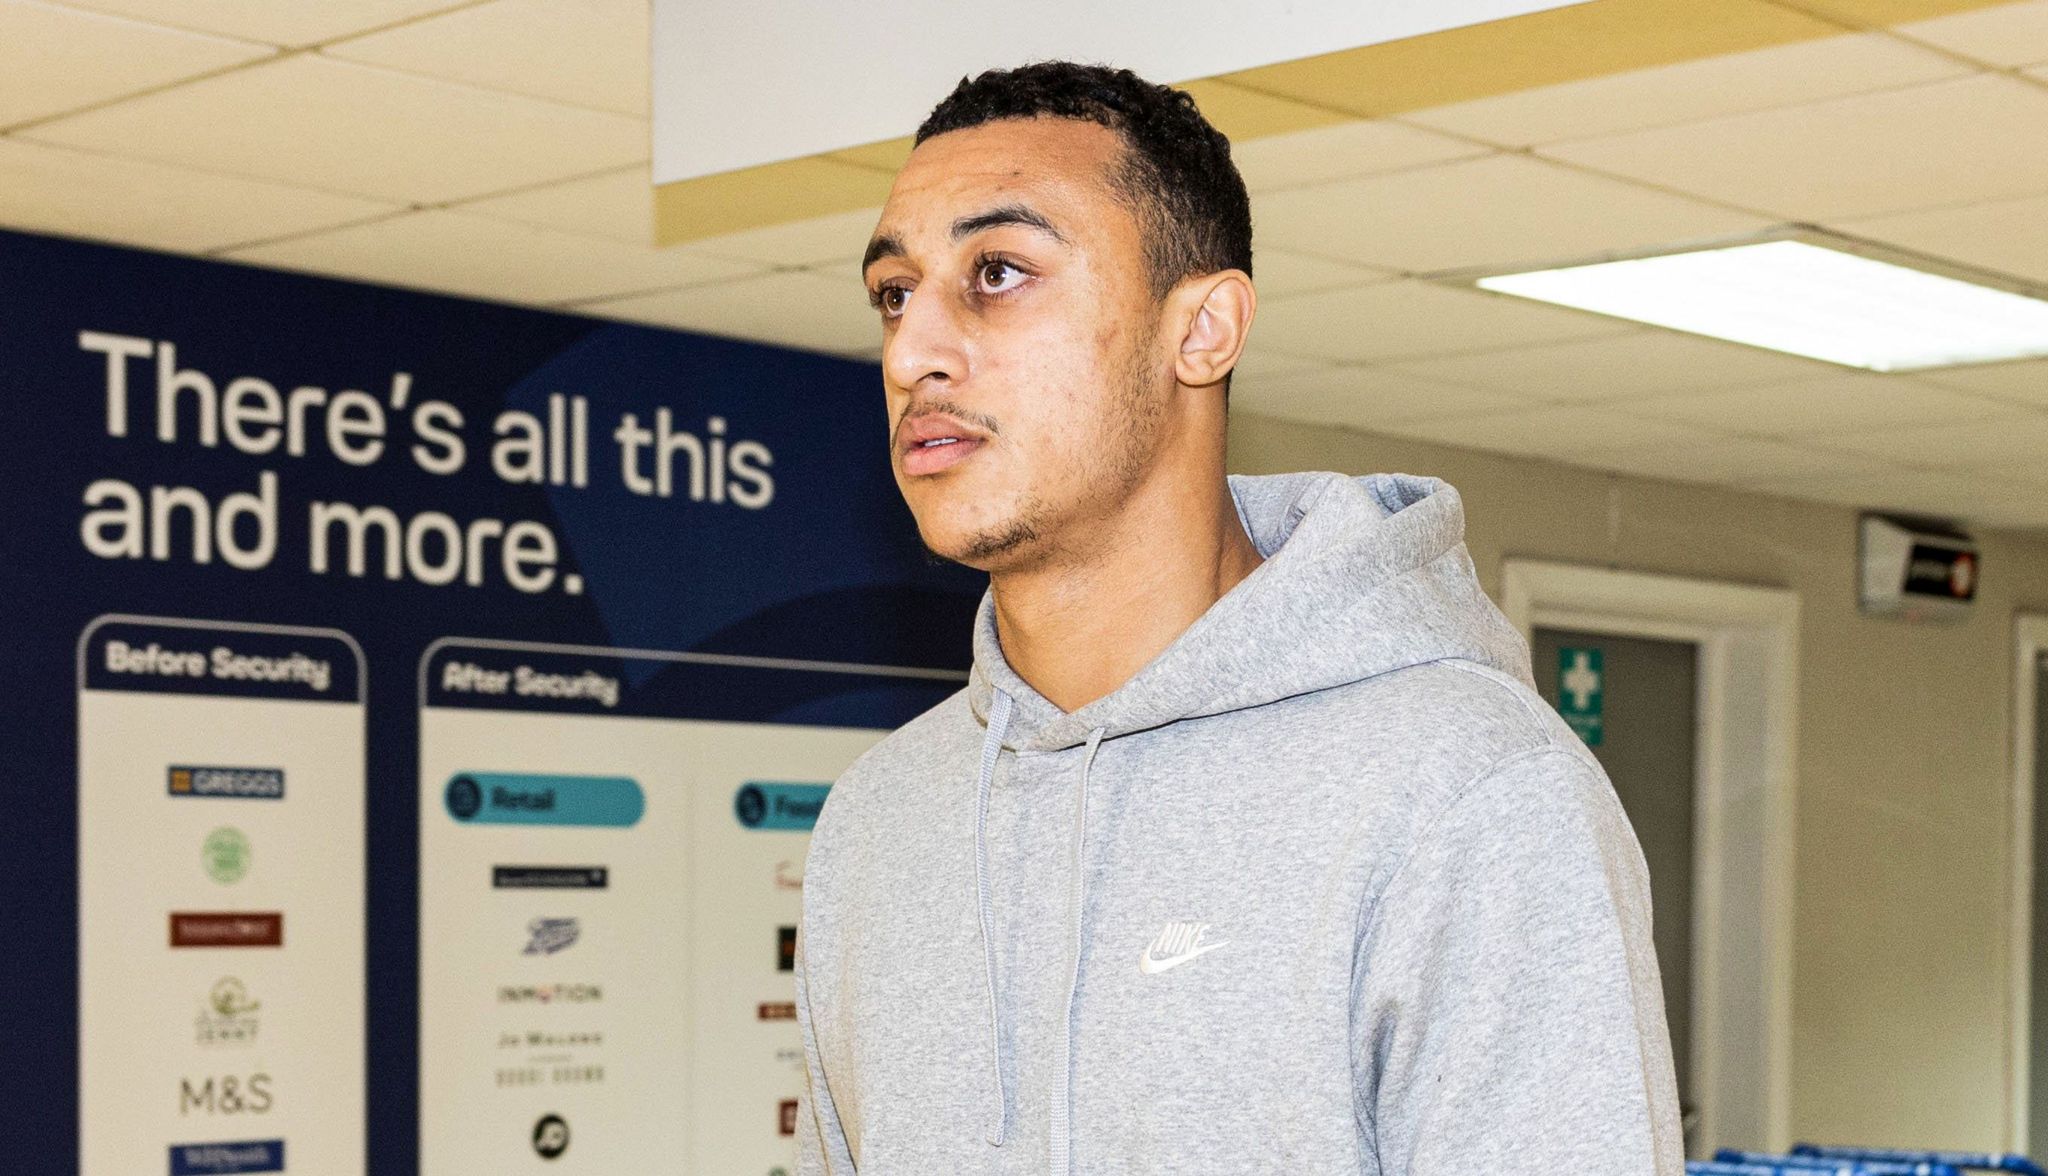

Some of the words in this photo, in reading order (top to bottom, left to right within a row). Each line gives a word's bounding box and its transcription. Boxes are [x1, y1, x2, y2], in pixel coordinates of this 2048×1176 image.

[78, 331, 466, 476] There's
[491, 393, 588, 489] all
[613, 407, 776, 510] this
[80, 470, 278, 571] and
[309, 500, 584, 595] more.
[105, 640, 207, 678] Before
[211, 646, 332, 692] Security
[442, 661, 510, 695] After
[513, 665, 620, 708] Security
[491, 785, 556, 811] Retail
[1154, 922, 1211, 954] NIKE
[179, 1073, 274, 1116] M&S
